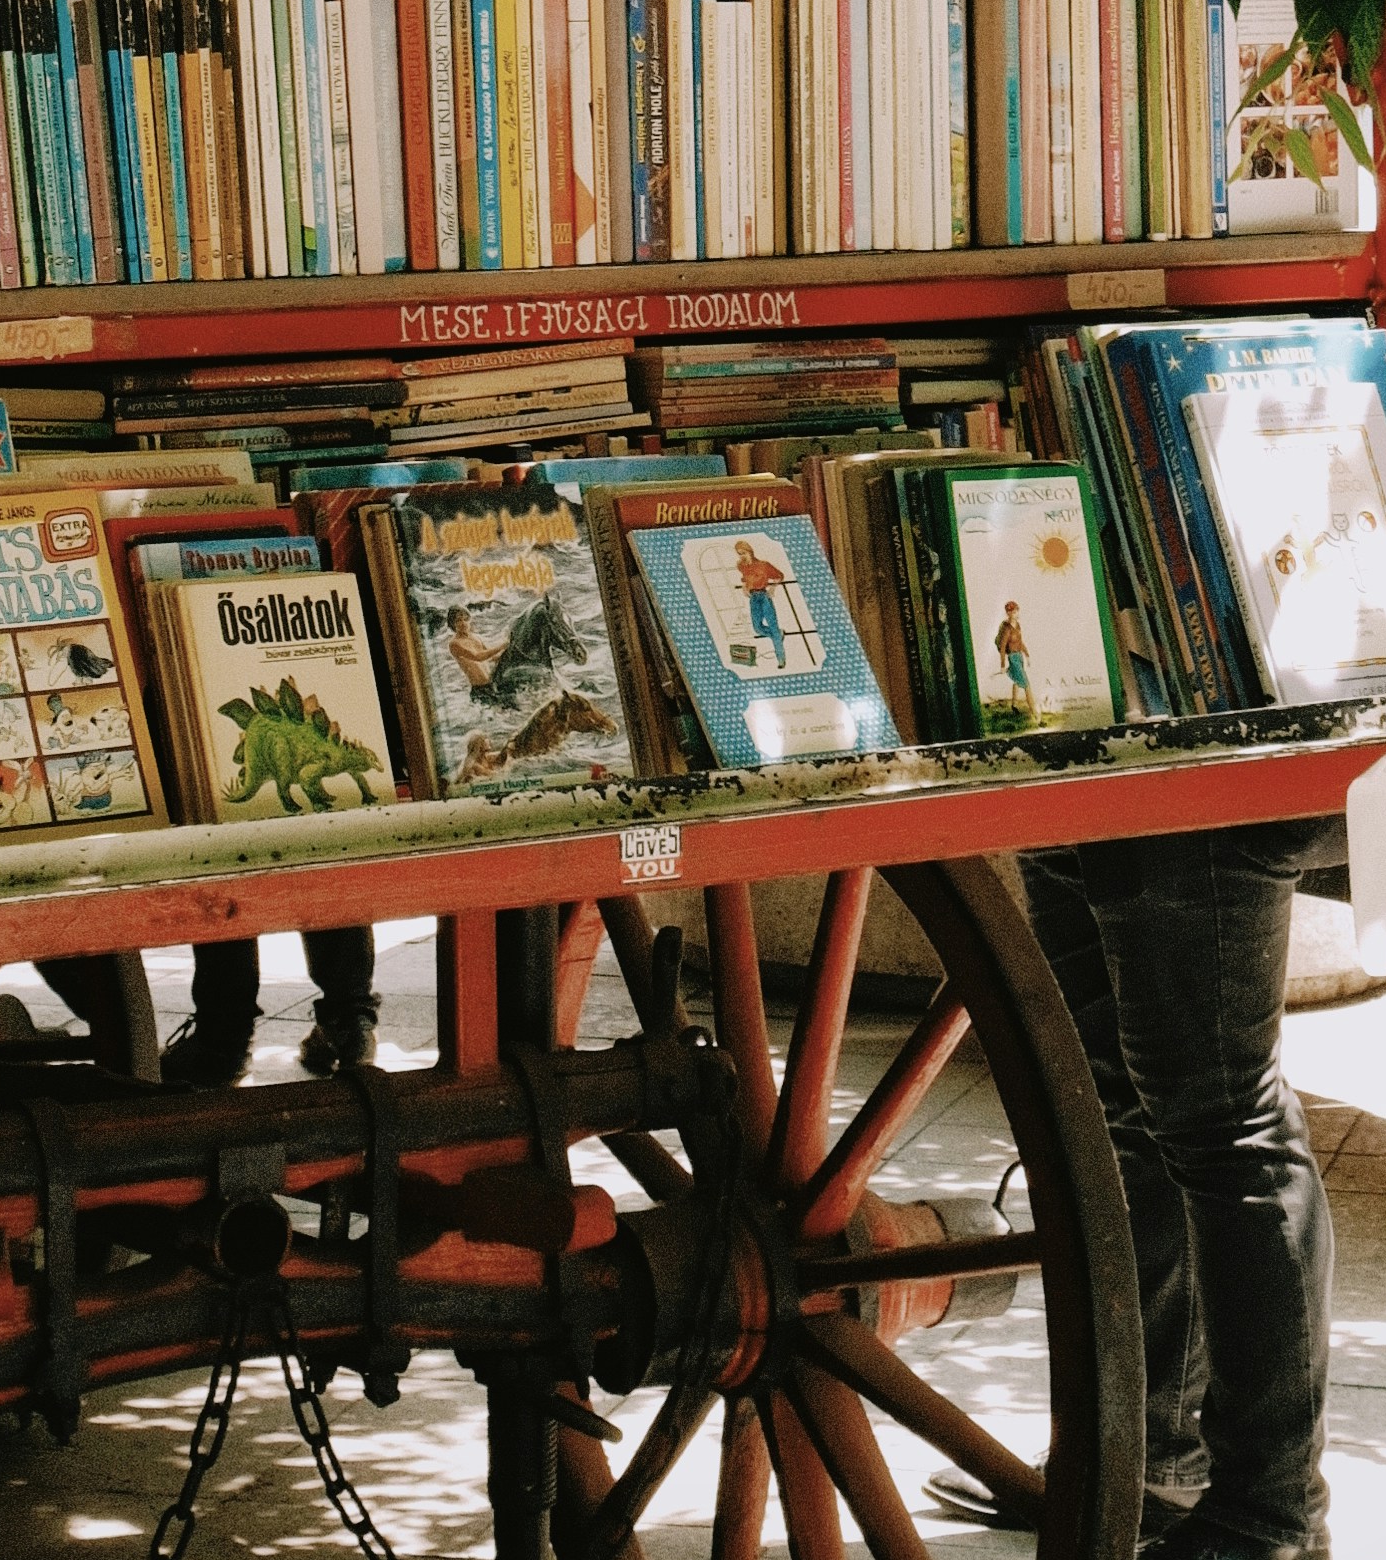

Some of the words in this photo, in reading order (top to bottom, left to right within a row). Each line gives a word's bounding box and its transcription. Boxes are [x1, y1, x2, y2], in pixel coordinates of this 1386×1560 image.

[433, 0, 447, 38] FINN
[434, 43, 451, 157] HUCKLEBERRY
[651, 86, 663, 115] MOLE
[652, 118, 664, 164] ADRIAN
[439, 163, 454, 207] Twain
[485, 169, 495, 206] TWAIN
[440, 211, 456, 253] Mark
[485, 209, 496, 243] MARK
[400, 304, 501, 344] MESE,
[667, 291, 800, 331] IRODALOM
[1227, 350, 1241, 367] J.
[1242, 349, 1260, 366] M.
[6, 505, 36, 521] JÁNOS
[655, 498, 734, 525] Benedek
[739, 495, 779, 519] Elek
[957, 490, 1028, 507] MICSODA
[1032, 485, 1077, 502] NÉGY
[51, 519, 91, 532] EXTRA
[420, 513, 439, 554] A
[185, 549, 247, 571] Thomas
[251, 546, 312, 572] Brezina
[217, 589, 356, 646] Ősállatok
[503, 778, 544, 793] Hughes
[626, 860, 676, 878] YOU
